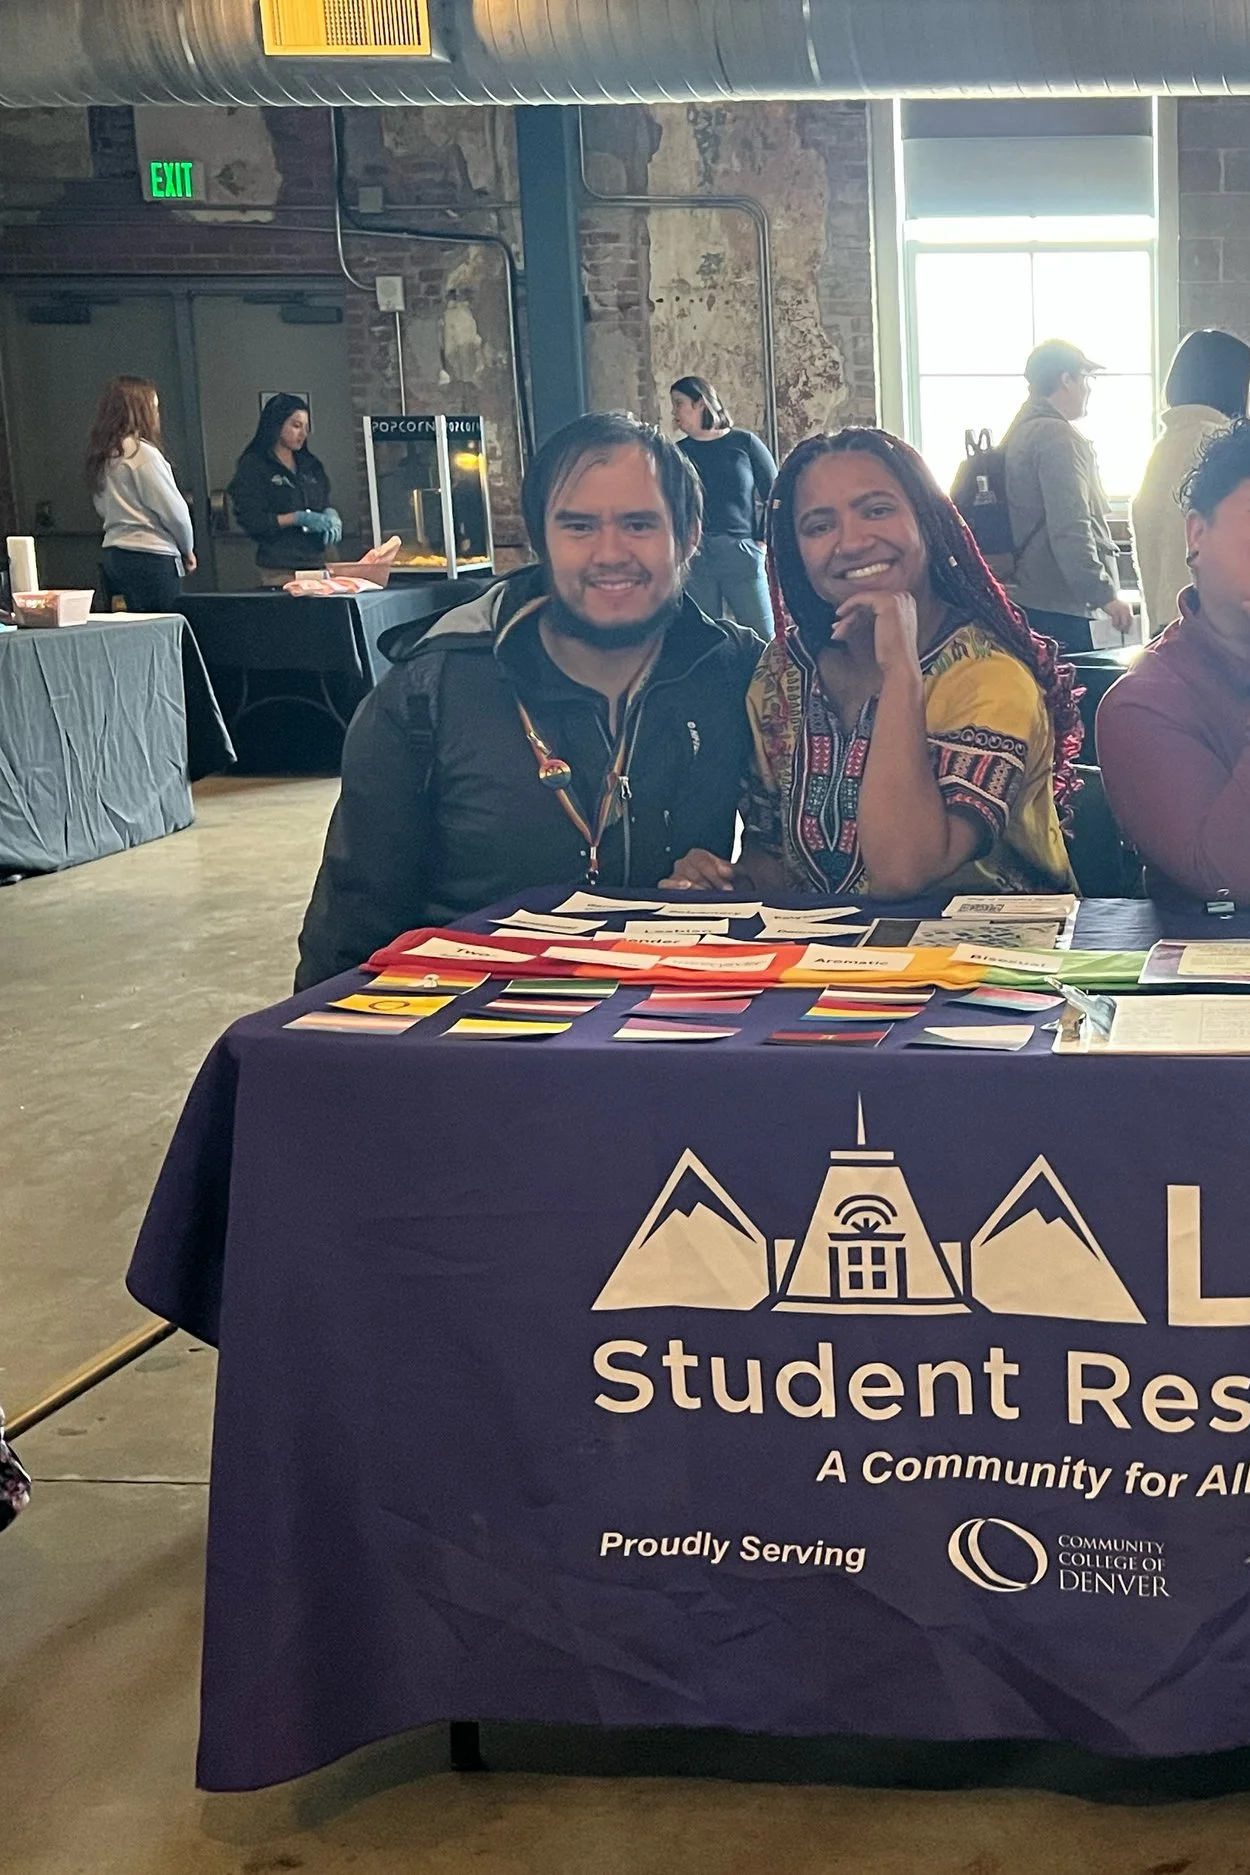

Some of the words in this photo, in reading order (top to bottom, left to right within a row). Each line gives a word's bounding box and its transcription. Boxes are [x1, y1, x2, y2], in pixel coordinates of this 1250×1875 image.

[150, 162, 193, 197] EXIT
[372, 421, 436, 432] POPCORN
[446, 421, 480, 432] OPCOR
[592, 1339, 1020, 1421] Student
[816, 1450, 847, 1483] A
[862, 1451, 1111, 1500] Community
[1125, 1461, 1189, 1498] for
[599, 1530, 731, 1564] Proudly
[739, 1535, 867, 1573] Serving
[1058, 1534, 1165, 1554] COMMUNITY
[1058, 1551, 1138, 1571] COLLEGE
[1142, 1557, 1166, 1572] OF
[1060, 1569, 1171, 1598] DENVER
